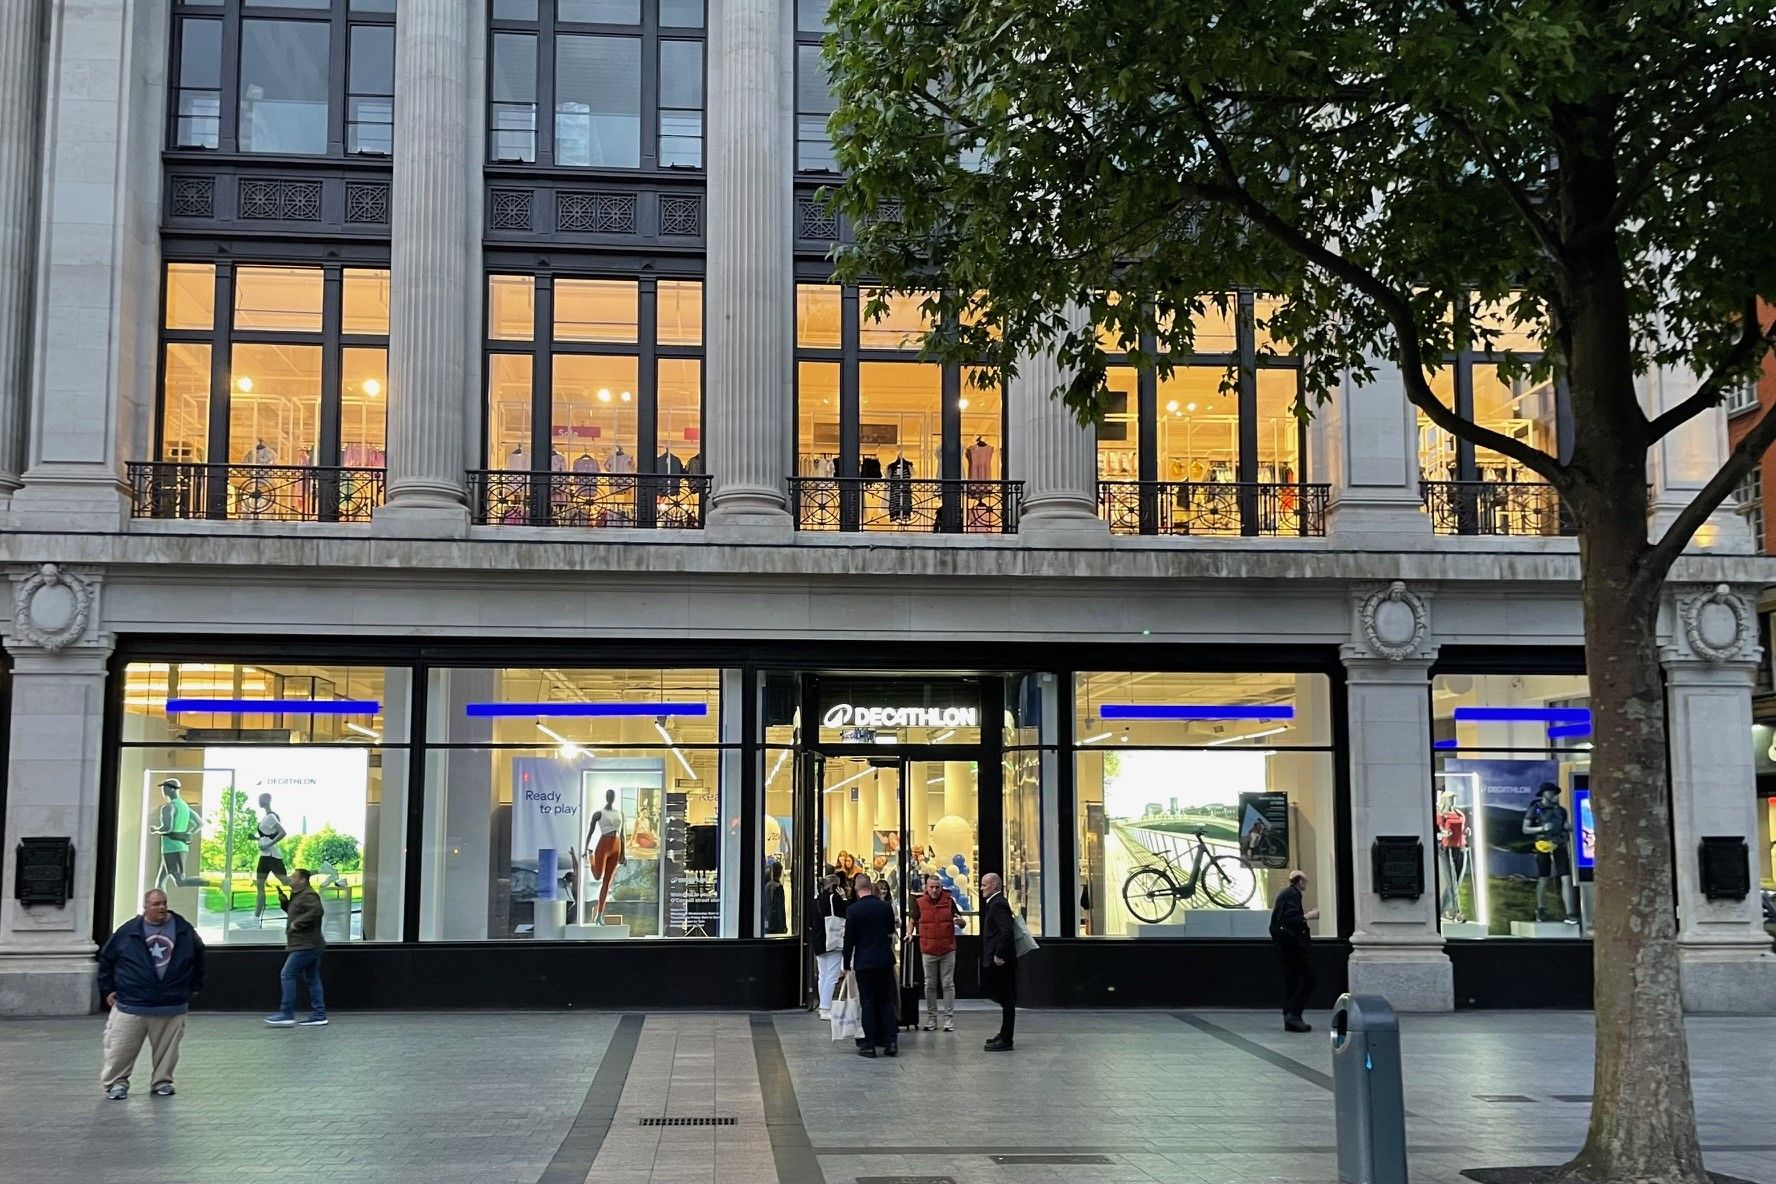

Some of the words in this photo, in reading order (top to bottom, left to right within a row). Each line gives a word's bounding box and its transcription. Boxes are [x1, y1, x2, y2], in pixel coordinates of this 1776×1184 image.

[854, 707, 976, 727] DECATHLON
[525, 790, 562, 802] Ready
[540, 804, 552, 814] to
[554, 803, 578, 816] play
